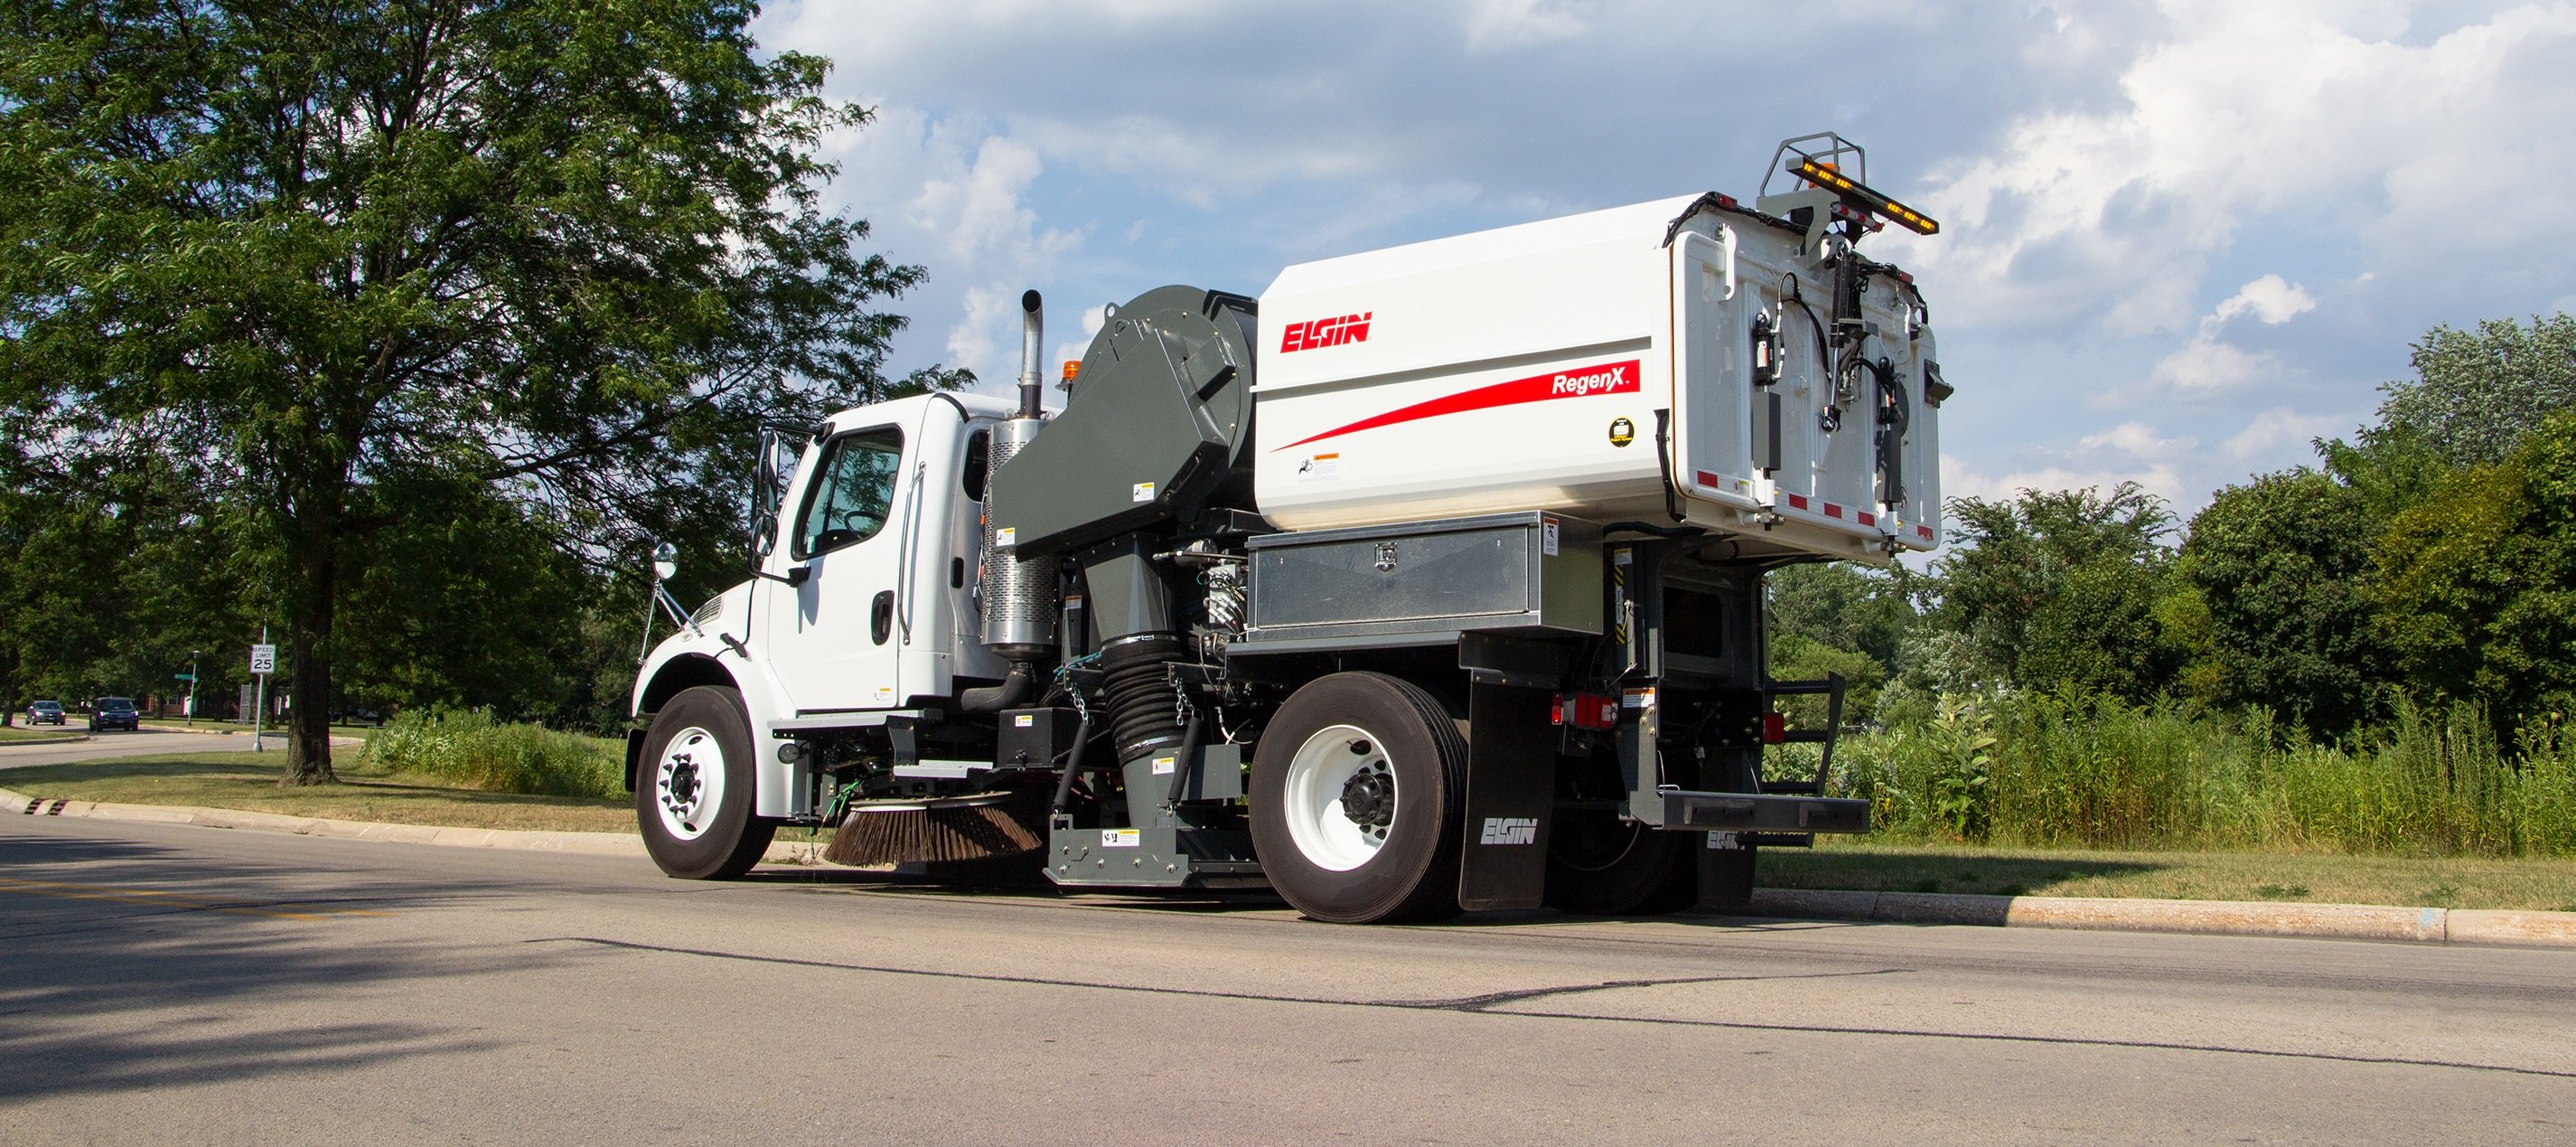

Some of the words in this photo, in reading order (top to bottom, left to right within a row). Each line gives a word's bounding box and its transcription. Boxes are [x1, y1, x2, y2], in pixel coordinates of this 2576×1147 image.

[1280, 311, 1372, 353] ELGIN
[1551, 366, 1625, 395] RegenX
[254, 659, 272, 670] 25
[1480, 817, 1539, 845] ELGIN
